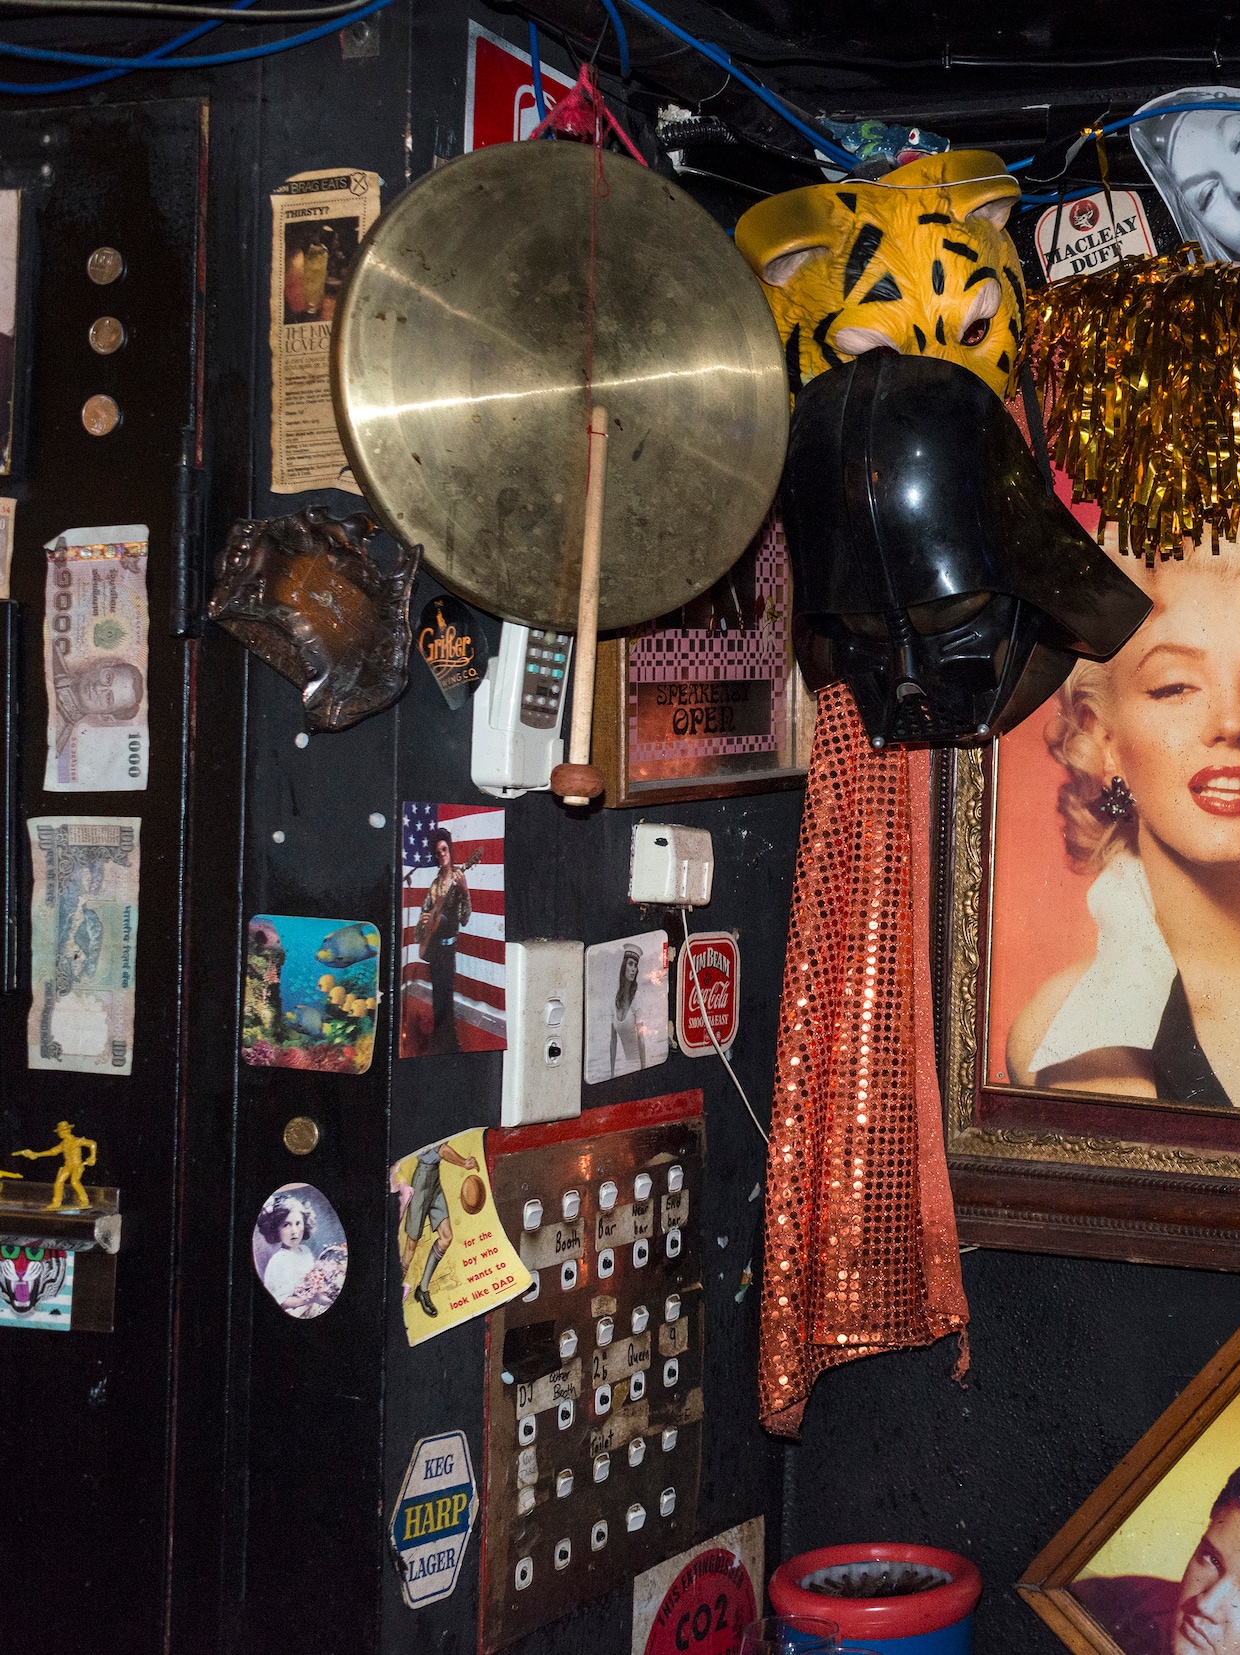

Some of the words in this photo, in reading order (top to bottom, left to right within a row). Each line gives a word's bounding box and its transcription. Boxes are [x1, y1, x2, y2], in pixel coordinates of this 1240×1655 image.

[290, 180, 319, 195] BRAG
[321, 177, 348, 191] EATS
[285, 206, 329, 219] THIRSTY?
[285, 326, 308, 340] THE
[418, 625, 472, 662] Grifter
[656, 682, 750, 706] SPEAKEASY
[672, 706, 736, 736] OPEN
[128, 732, 141, 778] 1000
[37, 825, 55, 851] 100
[119, 825, 135, 852] 100
[707, 947, 731, 979] BEAM
[111, 1040, 128, 1068] 100
[463, 1238, 476, 1248] for
[478, 1231, 493, 1242] the
[555, 1230, 581, 1254] Booth
[598, 1218, 617, 1240] Bar
[462, 1255, 477, 1267] boy
[480, 1247, 499, 1259] who
[467, 1267, 493, 1284] wants
[495, 1261, 507, 1271] to
[449, 1296, 470, 1310] look
[471, 1288, 490, 1301] like
[491, 1275, 515, 1292] DAD
[628, 1343, 650, 1367] Queen
[519, 1383, 533, 1407] DJ
[423, 1453, 454, 1481] KEG
[403, 1493, 468, 1541] HARP
[408, 1547, 457, 1583] LAGER
[658, 1587, 681, 1628] THIS
[675, 1593, 728, 1651] CO2
